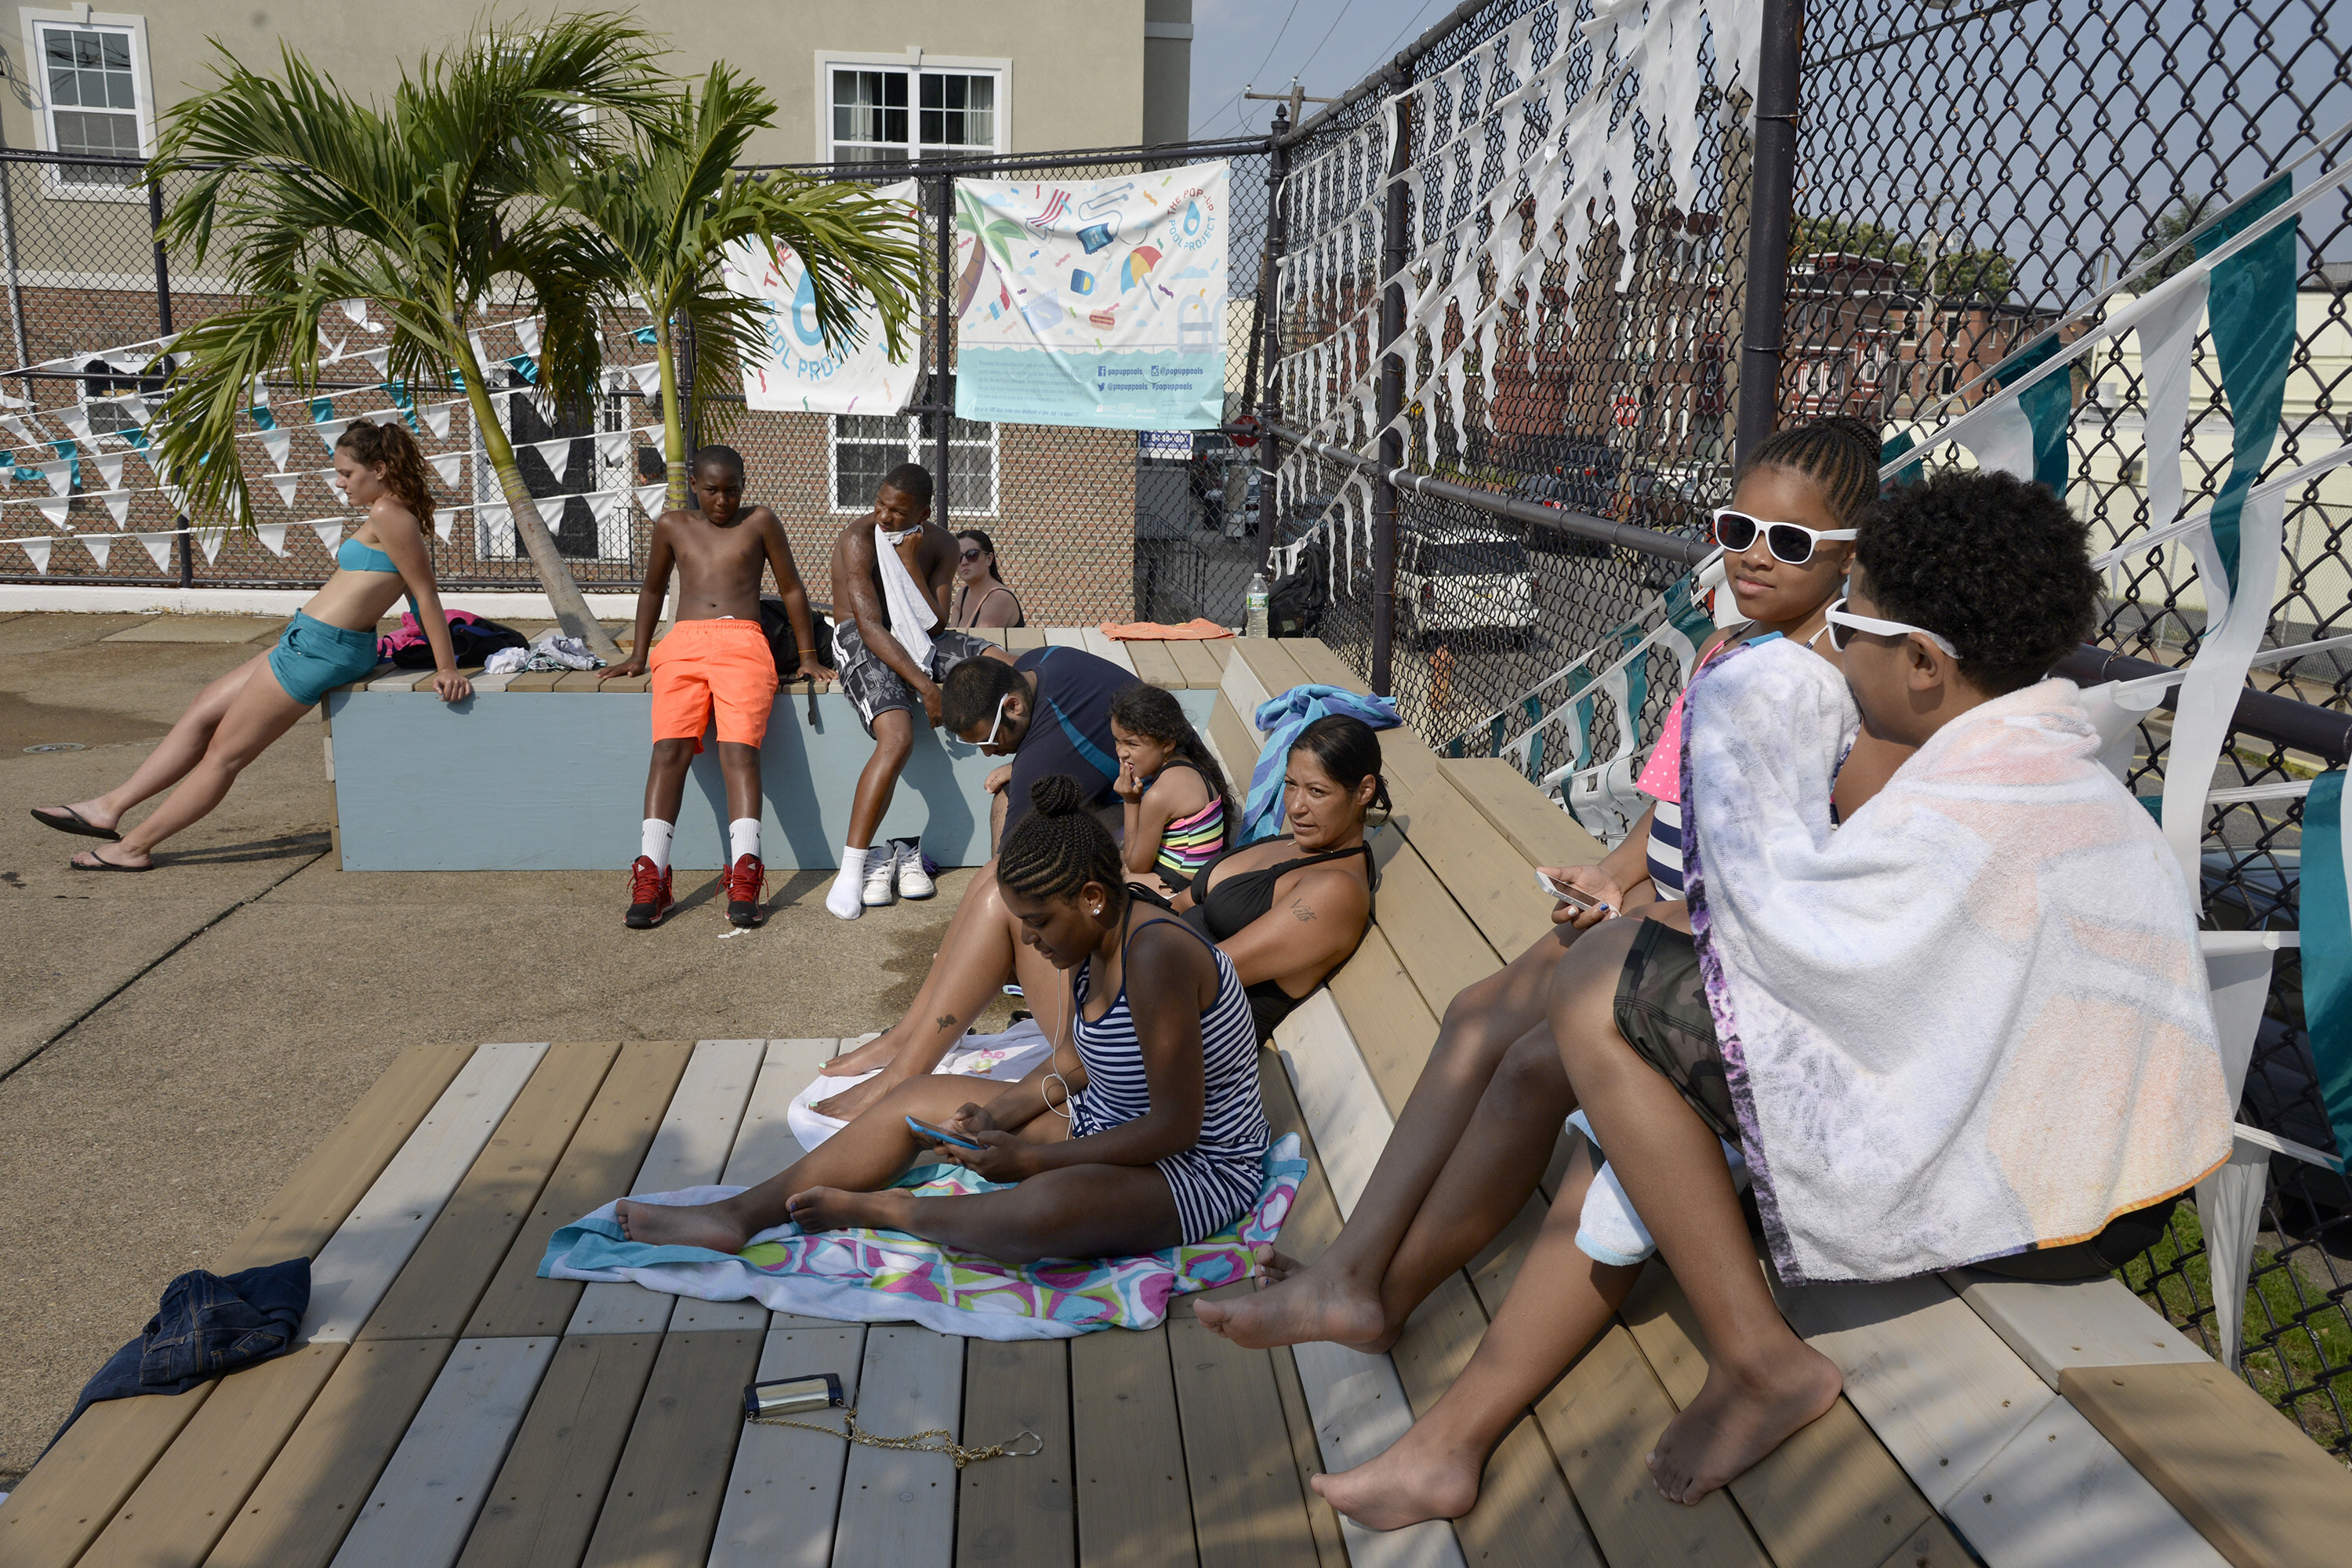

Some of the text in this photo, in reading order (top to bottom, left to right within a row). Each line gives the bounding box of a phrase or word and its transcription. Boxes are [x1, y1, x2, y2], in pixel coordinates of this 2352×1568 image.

[1167, 187, 1214, 216] THE POP-UP
[1169, 216, 1215, 251] POOL PROJECT
[764, 241, 792, 288] THE
[1108, 366, 1203, 377] popuppools @popuppools
[1108, 383, 1192, 391] @popuppools #popuppools
